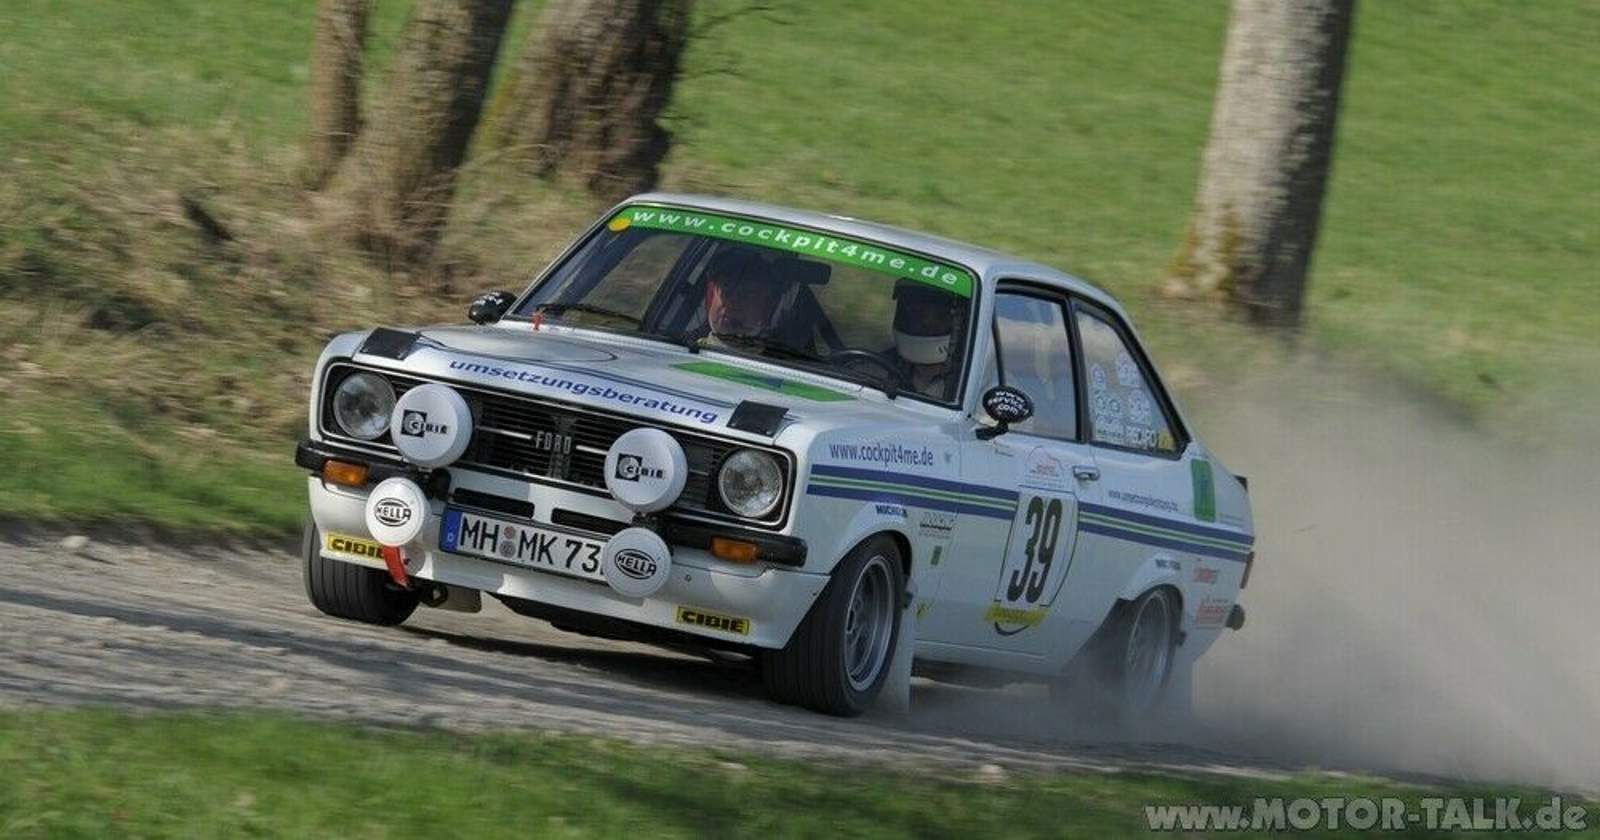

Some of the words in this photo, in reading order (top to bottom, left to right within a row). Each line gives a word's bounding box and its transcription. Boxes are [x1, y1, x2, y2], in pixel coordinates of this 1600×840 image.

[632, 210, 958, 285] www.cockpit4me.de
[449, 359, 719, 425] umsetzungsberatung
[535, 431, 572, 455] FORD
[828, 441, 934, 467] www.cockpit4me.de
[377, 505, 412, 521] HELLA
[460, 516, 500, 553] MH
[517, 529, 558, 565] MK
[565, 539, 605, 575] 73
[618, 555, 657, 576] HELLA
[1006, 495, 1063, 603] 39
